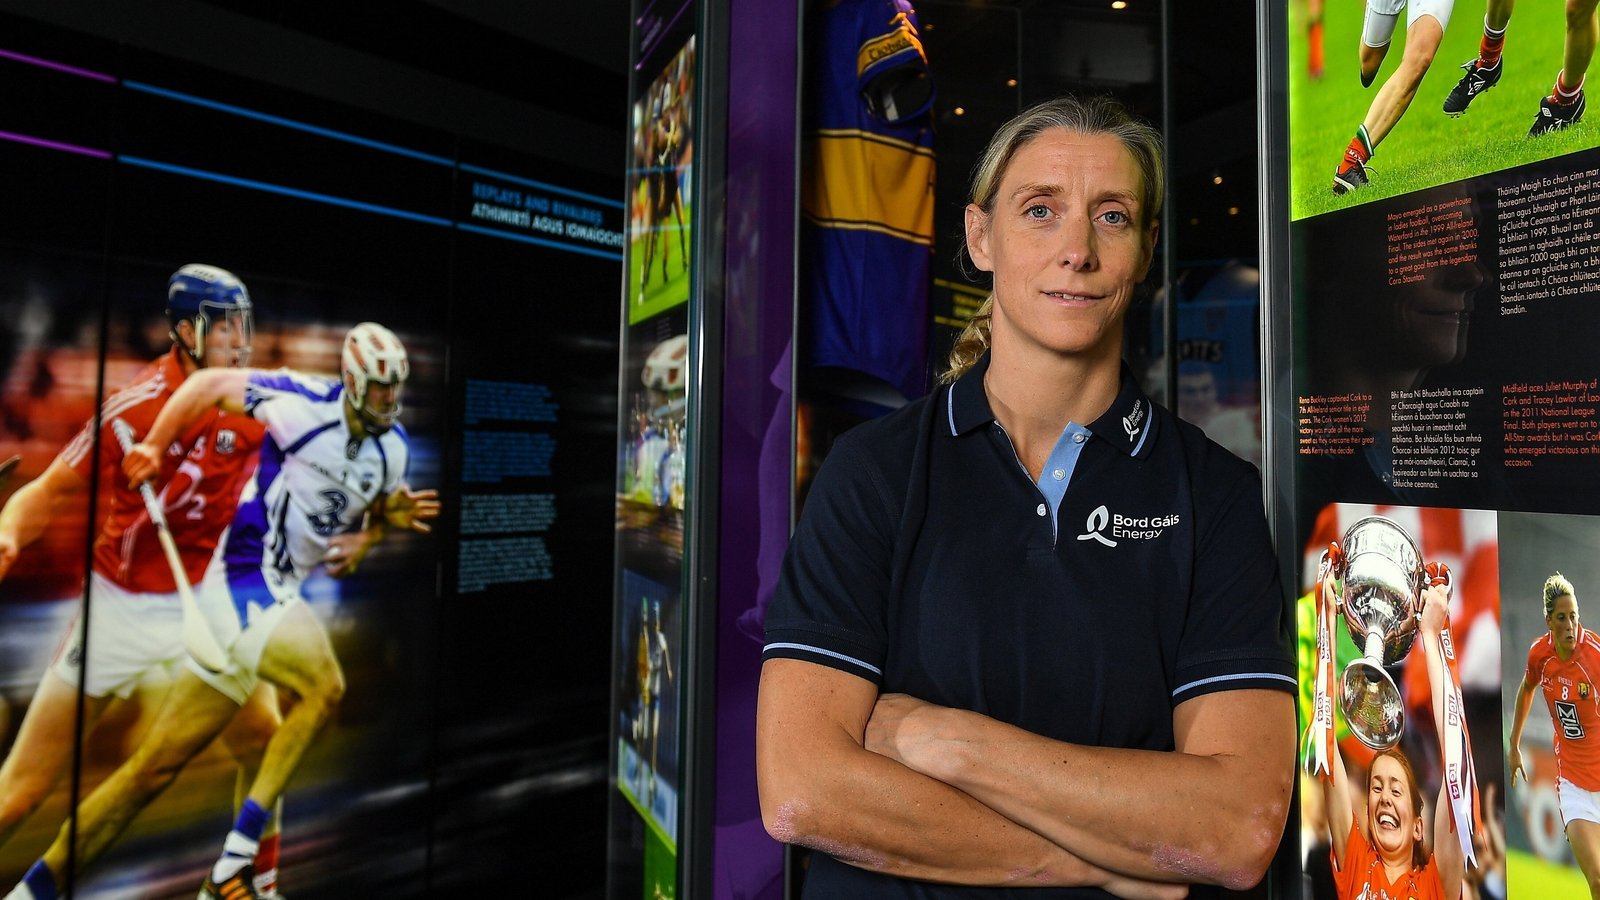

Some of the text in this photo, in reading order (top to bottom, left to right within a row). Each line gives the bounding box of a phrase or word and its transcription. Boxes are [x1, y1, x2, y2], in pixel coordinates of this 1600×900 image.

[1497, 186, 1519, 196] Tháinig
[1521, 179, 1541, 191] Maigh
[1543, 178, 1551, 186] Eo
[1553, 175, 1568, 184] chun
[1570, 172, 1584, 180] cinn
[1498, 197, 1526, 208] fhoireann
[1528, 185, 1572, 202] chumhachtach
[1574, 180, 1591, 194] pheil
[1498, 211, 1515, 220] mban
[1517, 208, 1531, 218] agus
[1533, 200, 1558, 213] bhuaigh
[1570, 194, 1586, 205] Phort
[1502, 221, 1528, 234] gCluiche
[1530, 214, 1559, 226] Ceannais
[1507, 232, 1528, 242] bhliain
[1531, 227, 1549, 238] 1999.
[1552, 222, 1571, 234] Bhuail
[1584, 219, 1593, 228] dá
[1503, 383, 1527, 393] Midfield
[1545, 382, 1560, 392] Juliet
[1563, 380, 1588, 392] Murphy
[1590, 379, 1597, 389] of
[1503, 396, 1517, 405] Cork
[1520, 396, 1531, 404] and
[1533, 395, 1553, 406] Tracey
[1556, 393, 1576, 403] Lawlor
[1579, 392, 1585, 401] of
[1511, 409, 1520, 417] the
[1522, 408, 1538, 417] 2011
[1541, 407, 1568, 416] National
[1571, 407, 1595, 418] League
[1504, 421, 1520, 429] Final.
[1522, 420, 1535, 429] Both
[1538, 420, 1560, 431] players
[1504, 432, 1524, 442] All-Star
[1527, 432, 1550, 441] awards
[1552, 432, 1562, 441] but
[1504, 445, 1517, 454] who
[1519, 444, 1546, 456] emerged
[1504, 458, 1533, 466] occasion.
[1113, 514, 1179, 528] Bord Gáis
[1113, 526, 1162, 540] Energy
[1562, 686, 1568, 700] 8
